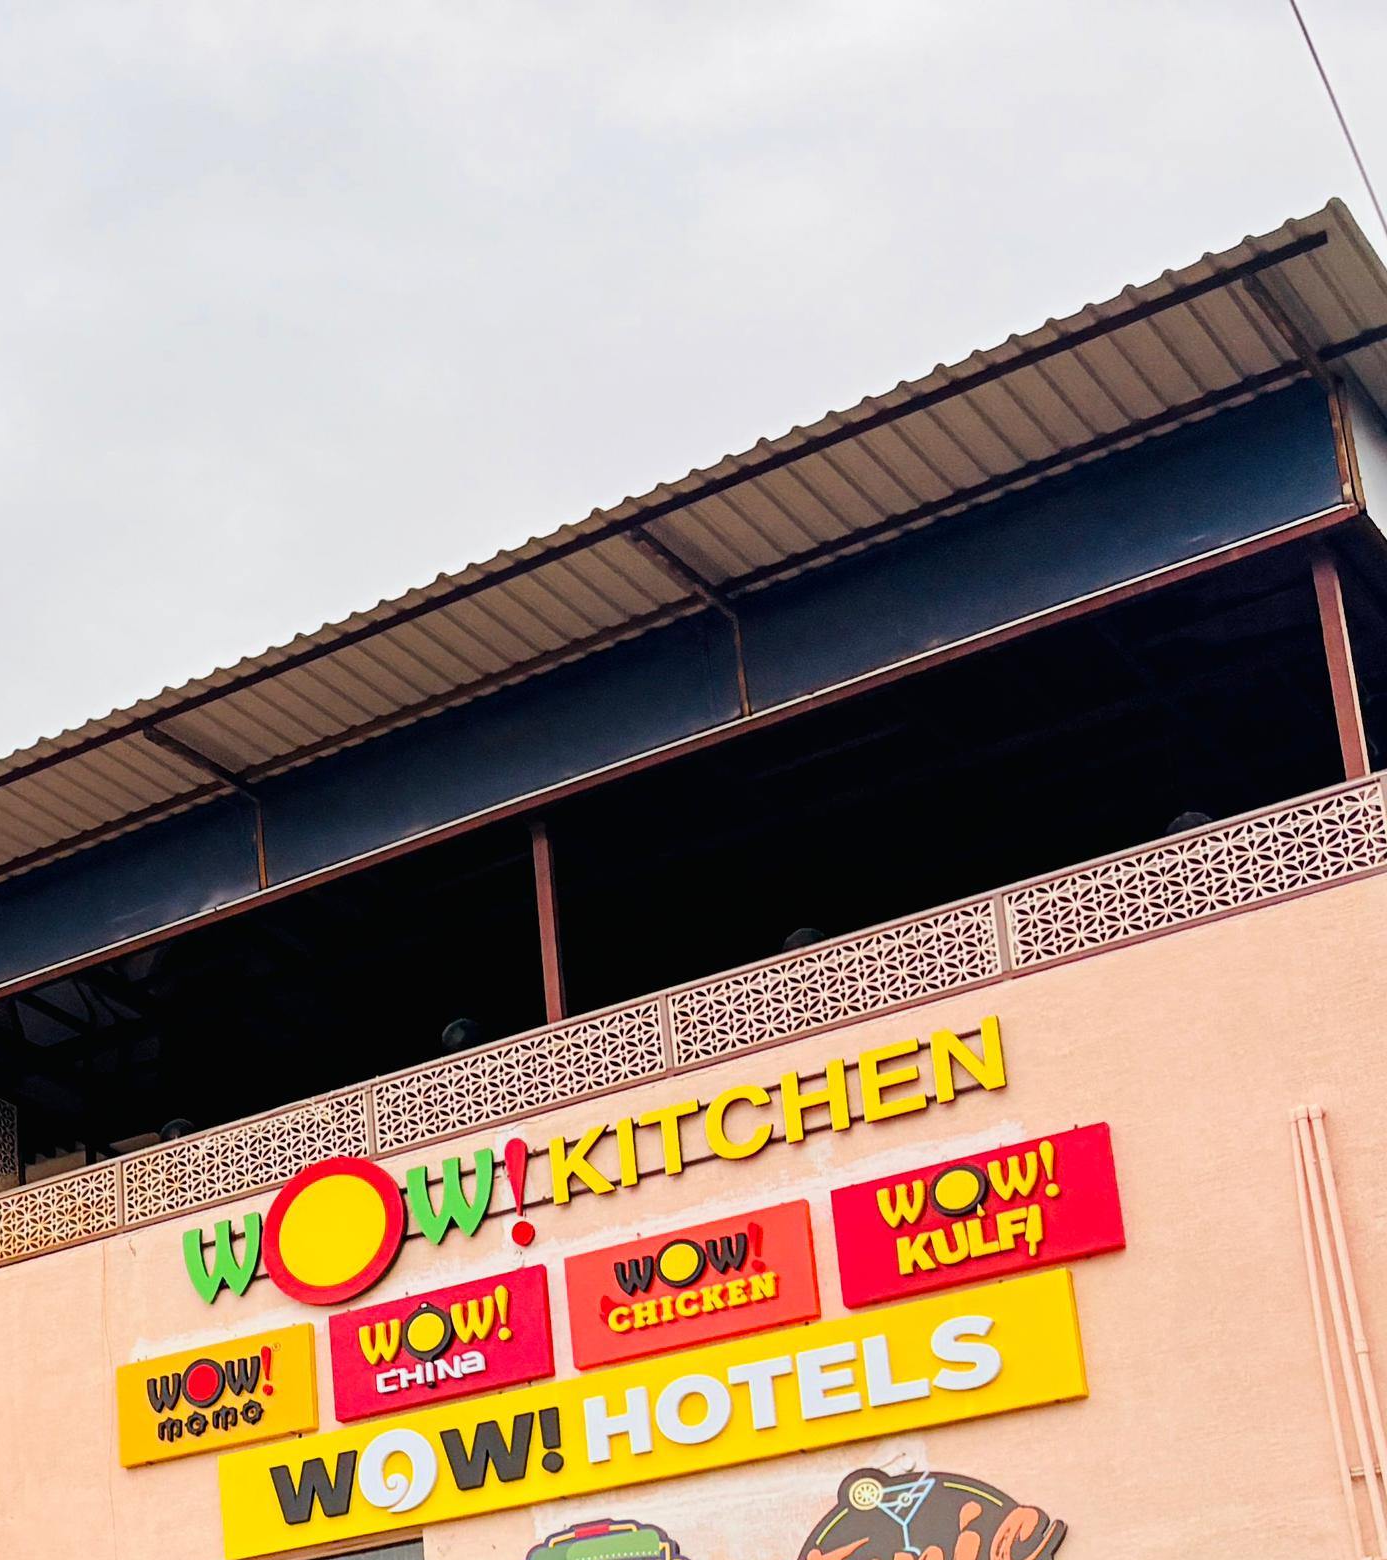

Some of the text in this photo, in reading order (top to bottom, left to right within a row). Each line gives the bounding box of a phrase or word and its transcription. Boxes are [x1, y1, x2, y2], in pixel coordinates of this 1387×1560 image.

[183, 1014, 1008, 1306] WOW! KITCHEN
[876, 1140, 1061, 1229] WOW!
[614, 1221, 766, 1297] WOW!
[358, 1285, 514, 1366] WOW!
[607, 1271, 779, 1333] CHICKEN
[146, 1345, 274, 1413] WOW!
[269, 1315, 1003, 1526] WOW! HOTELS
